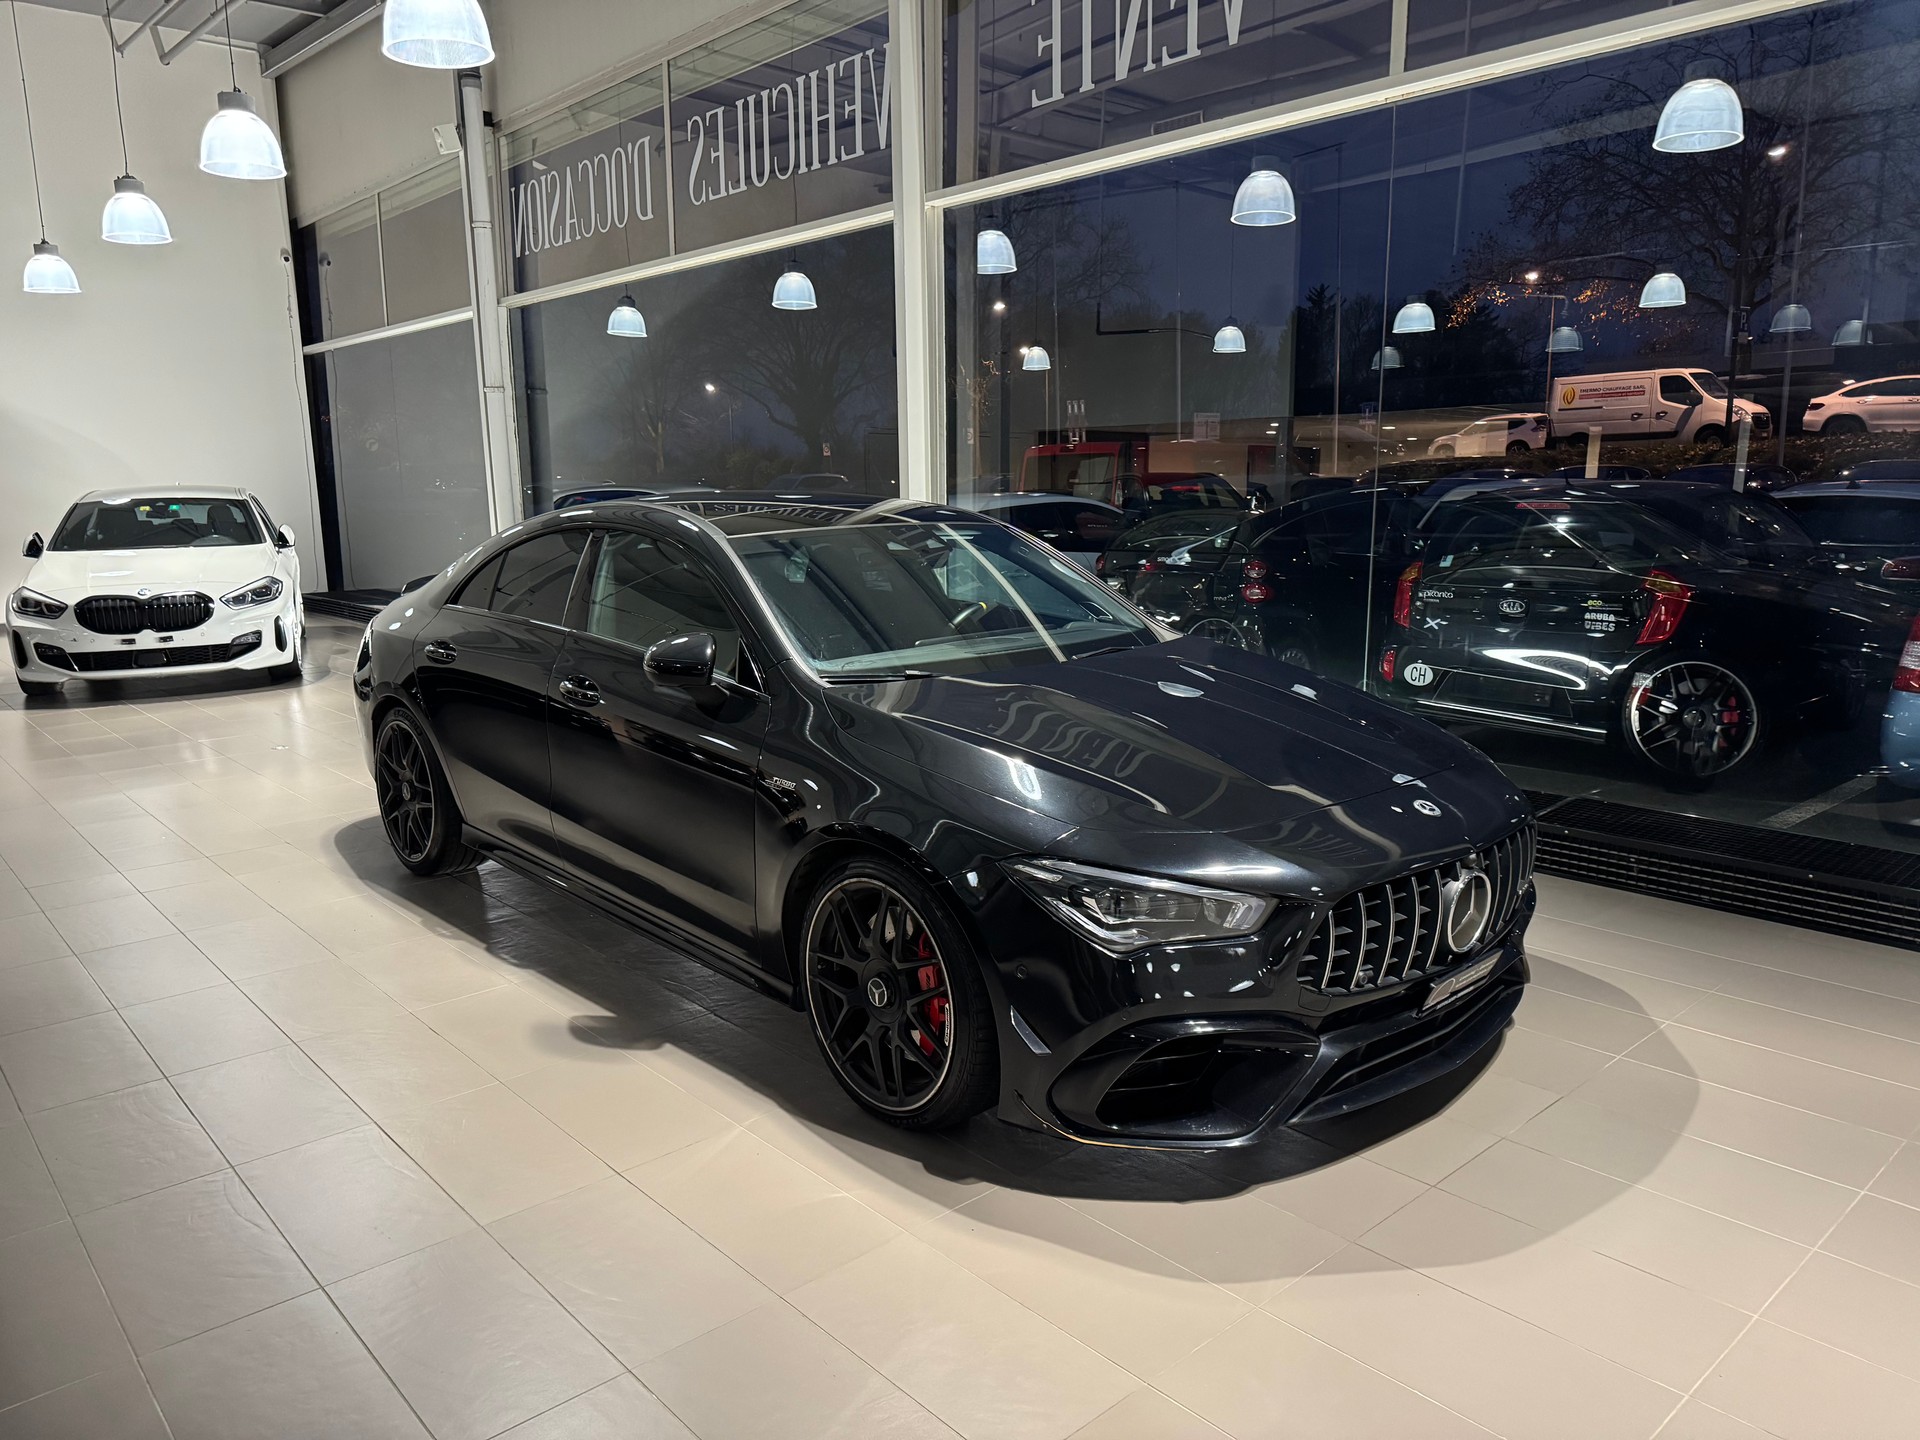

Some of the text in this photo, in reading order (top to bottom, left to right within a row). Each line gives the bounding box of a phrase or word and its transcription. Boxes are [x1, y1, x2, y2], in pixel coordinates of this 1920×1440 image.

[1502, 601, 1521, 611] KIA
[1584, 612, 1616, 621] ARUBA
[1410, 666, 1427, 684] CH
